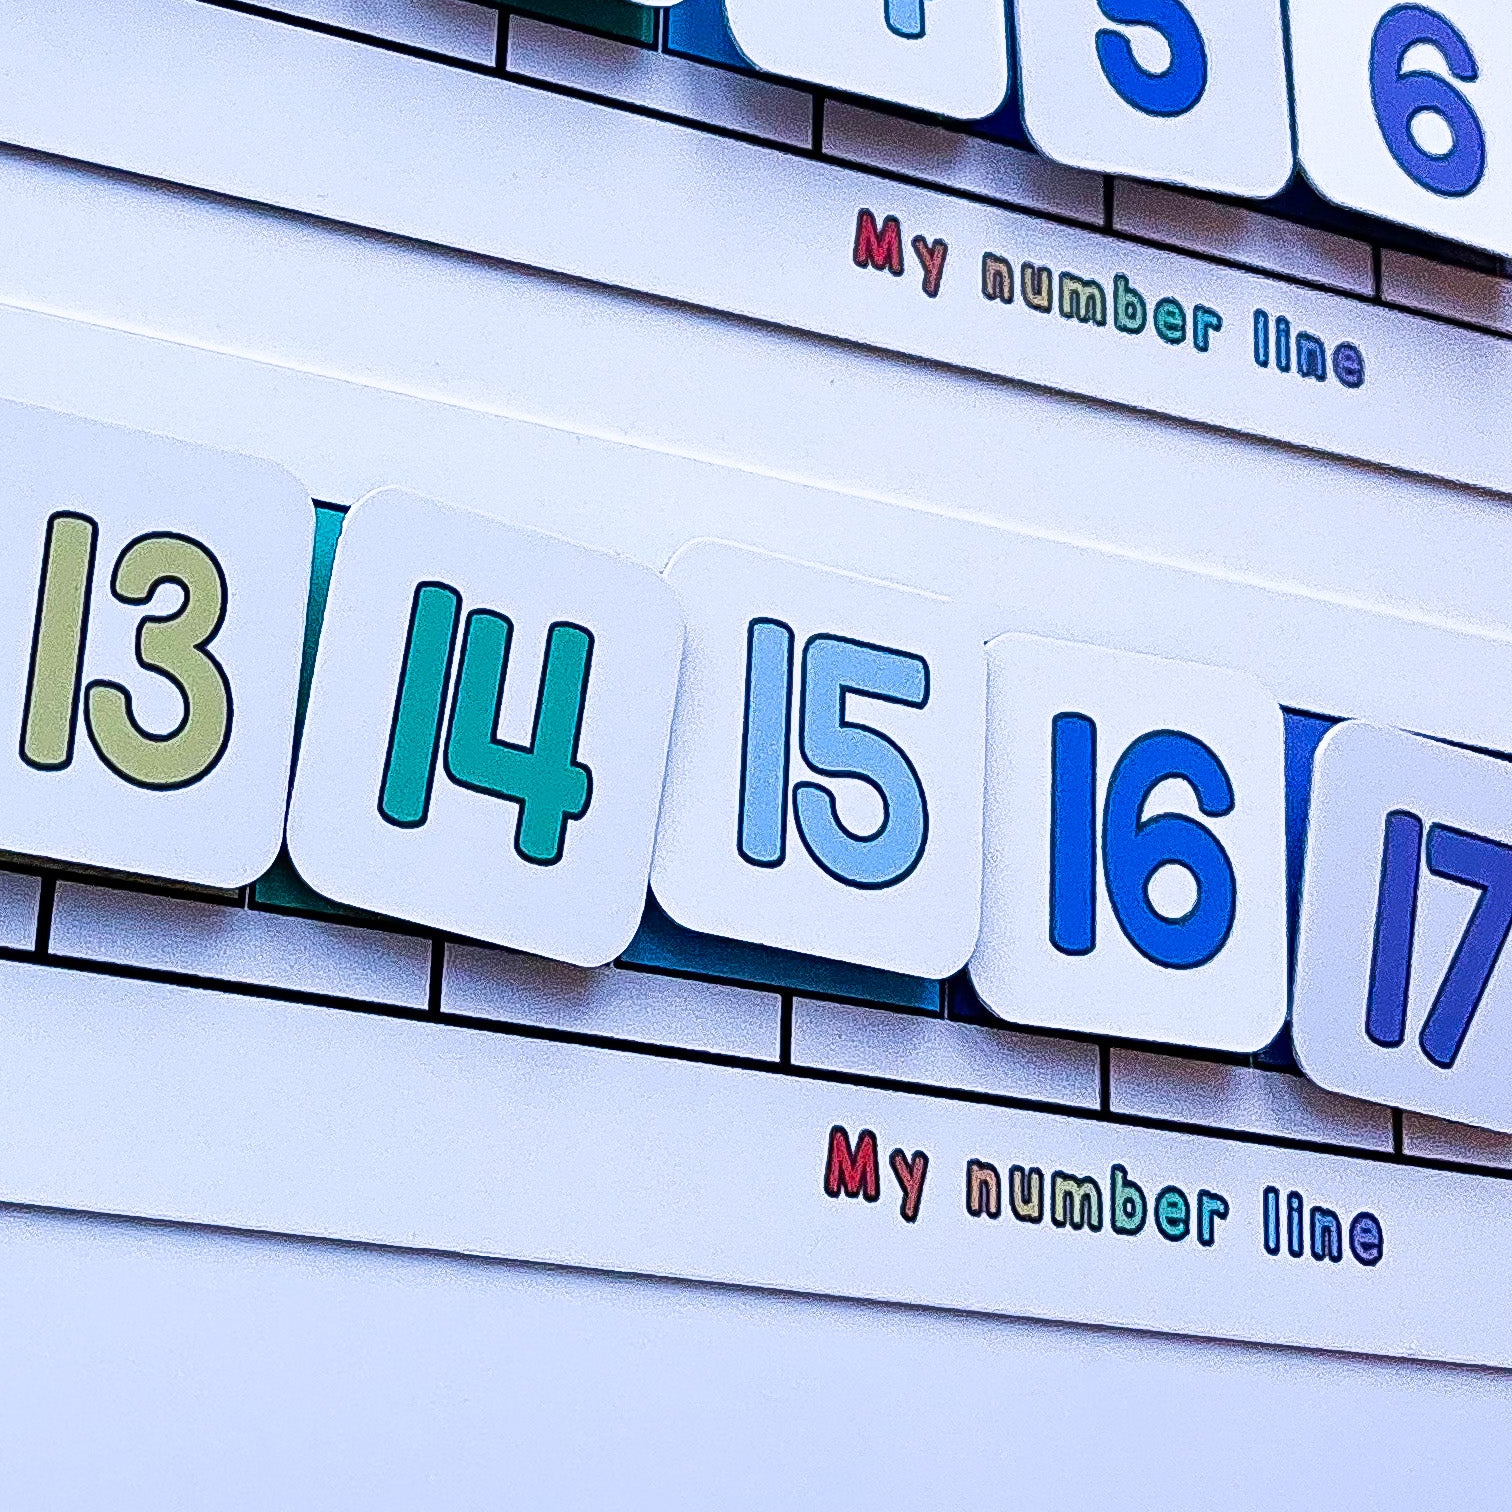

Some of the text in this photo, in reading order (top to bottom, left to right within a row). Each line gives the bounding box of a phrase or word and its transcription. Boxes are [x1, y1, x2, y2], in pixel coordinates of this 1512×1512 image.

[1368, 3, 1487, 198] 6
[853, 208, 1366, 388] My number line
[18, 510, 234, 792] 13
[377, 581, 595, 867] 14
[736, 617, 930, 890] 15
[1049, 712, 1237, 970] 16
[1365, 808, 1512, 1070] 17
[824, 1125, 1385, 1267] My number line
